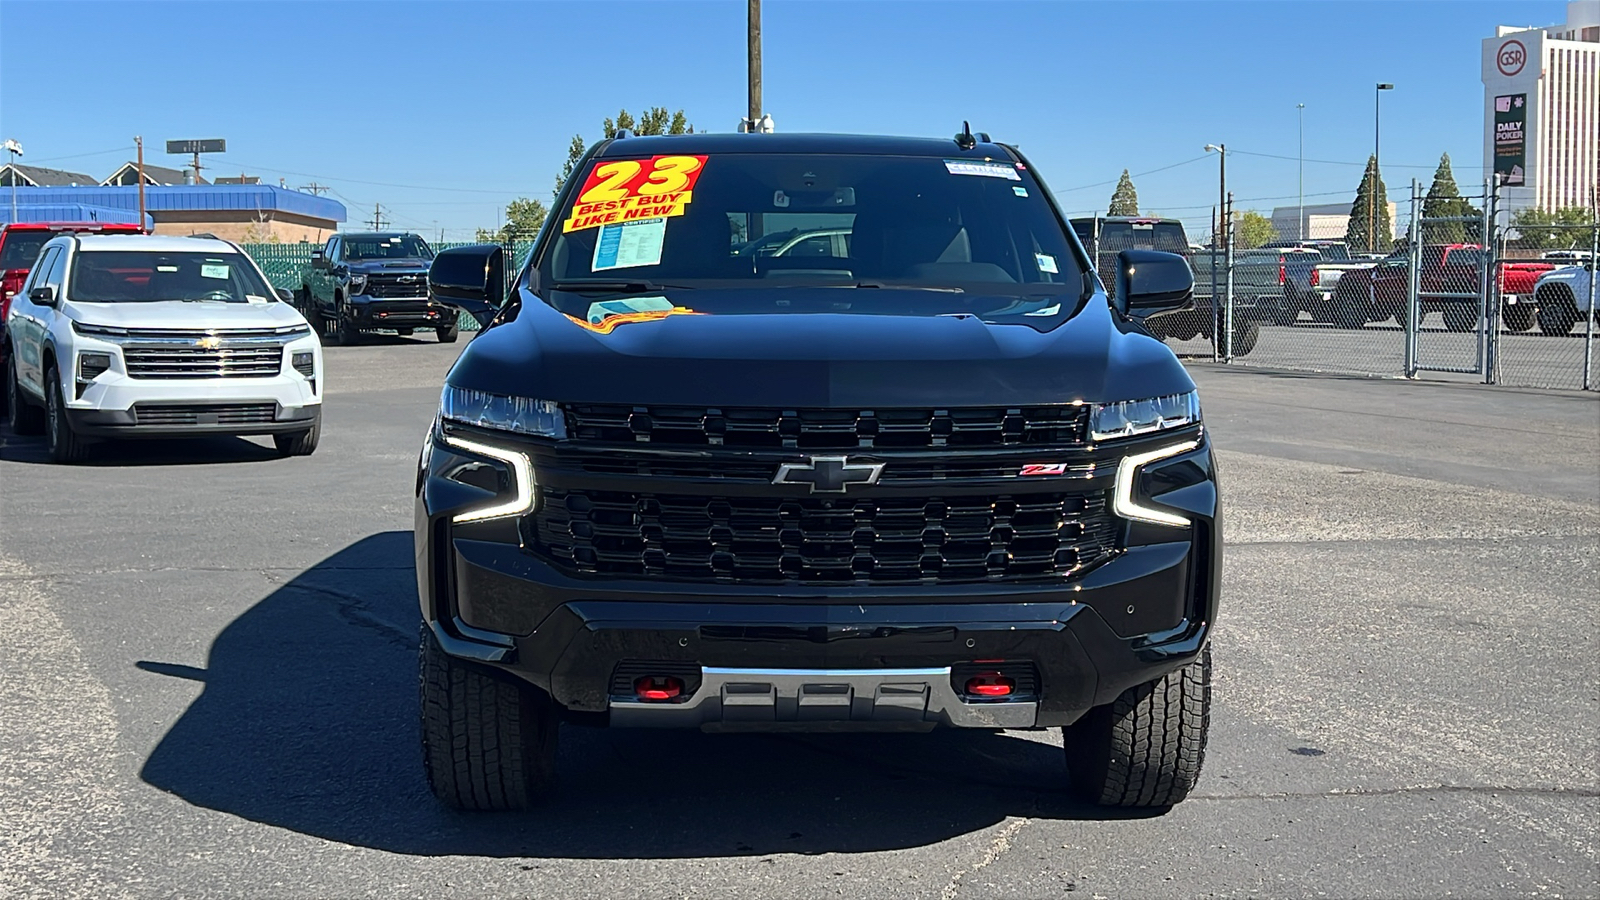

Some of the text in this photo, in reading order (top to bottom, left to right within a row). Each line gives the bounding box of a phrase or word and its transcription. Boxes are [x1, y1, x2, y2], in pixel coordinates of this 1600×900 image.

[1500, 50, 1522, 66] GSR
[1497, 121, 1522, 131] DAILY
[1496, 131, 1523, 140] POKER
[580, 156, 701, 202] 23
[578, 193, 682, 215] BEST BUY
[571, 205, 674, 228] LIKE NEW
[624, 218, 661, 226] CERTIFIED
